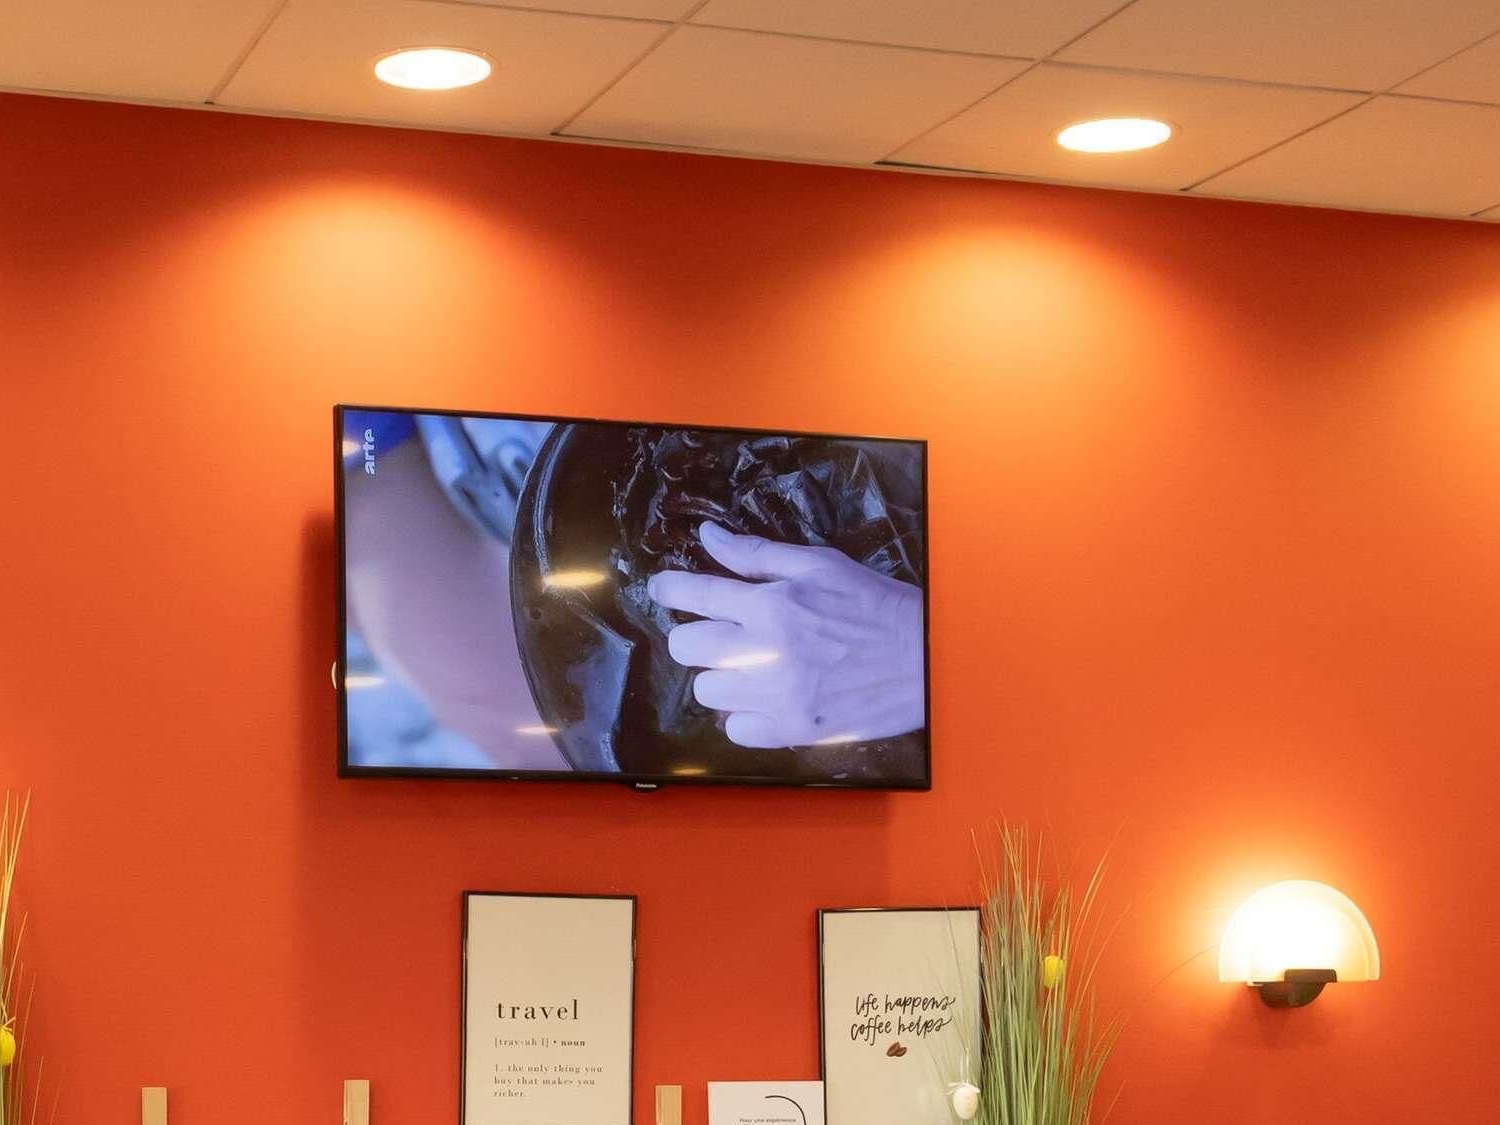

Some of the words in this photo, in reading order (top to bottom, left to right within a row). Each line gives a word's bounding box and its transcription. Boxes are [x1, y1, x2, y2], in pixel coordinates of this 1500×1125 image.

[363, 428, 375, 475] arte
[496, 998, 580, 1020] travel
[855, 993, 879, 1018] life
[884, 994, 956, 1015] happens
[850, 1014, 892, 1046] coffee
[897, 1015, 953, 1039] helps
[560, 1039, 586, 1047] noun
[507, 1063, 524, 1073] the
[527, 1064, 549, 1075] only
[553, 1064, 581, 1075] thing
[516, 1076, 539, 1086] that
[542, 1076, 574, 1086] makes
